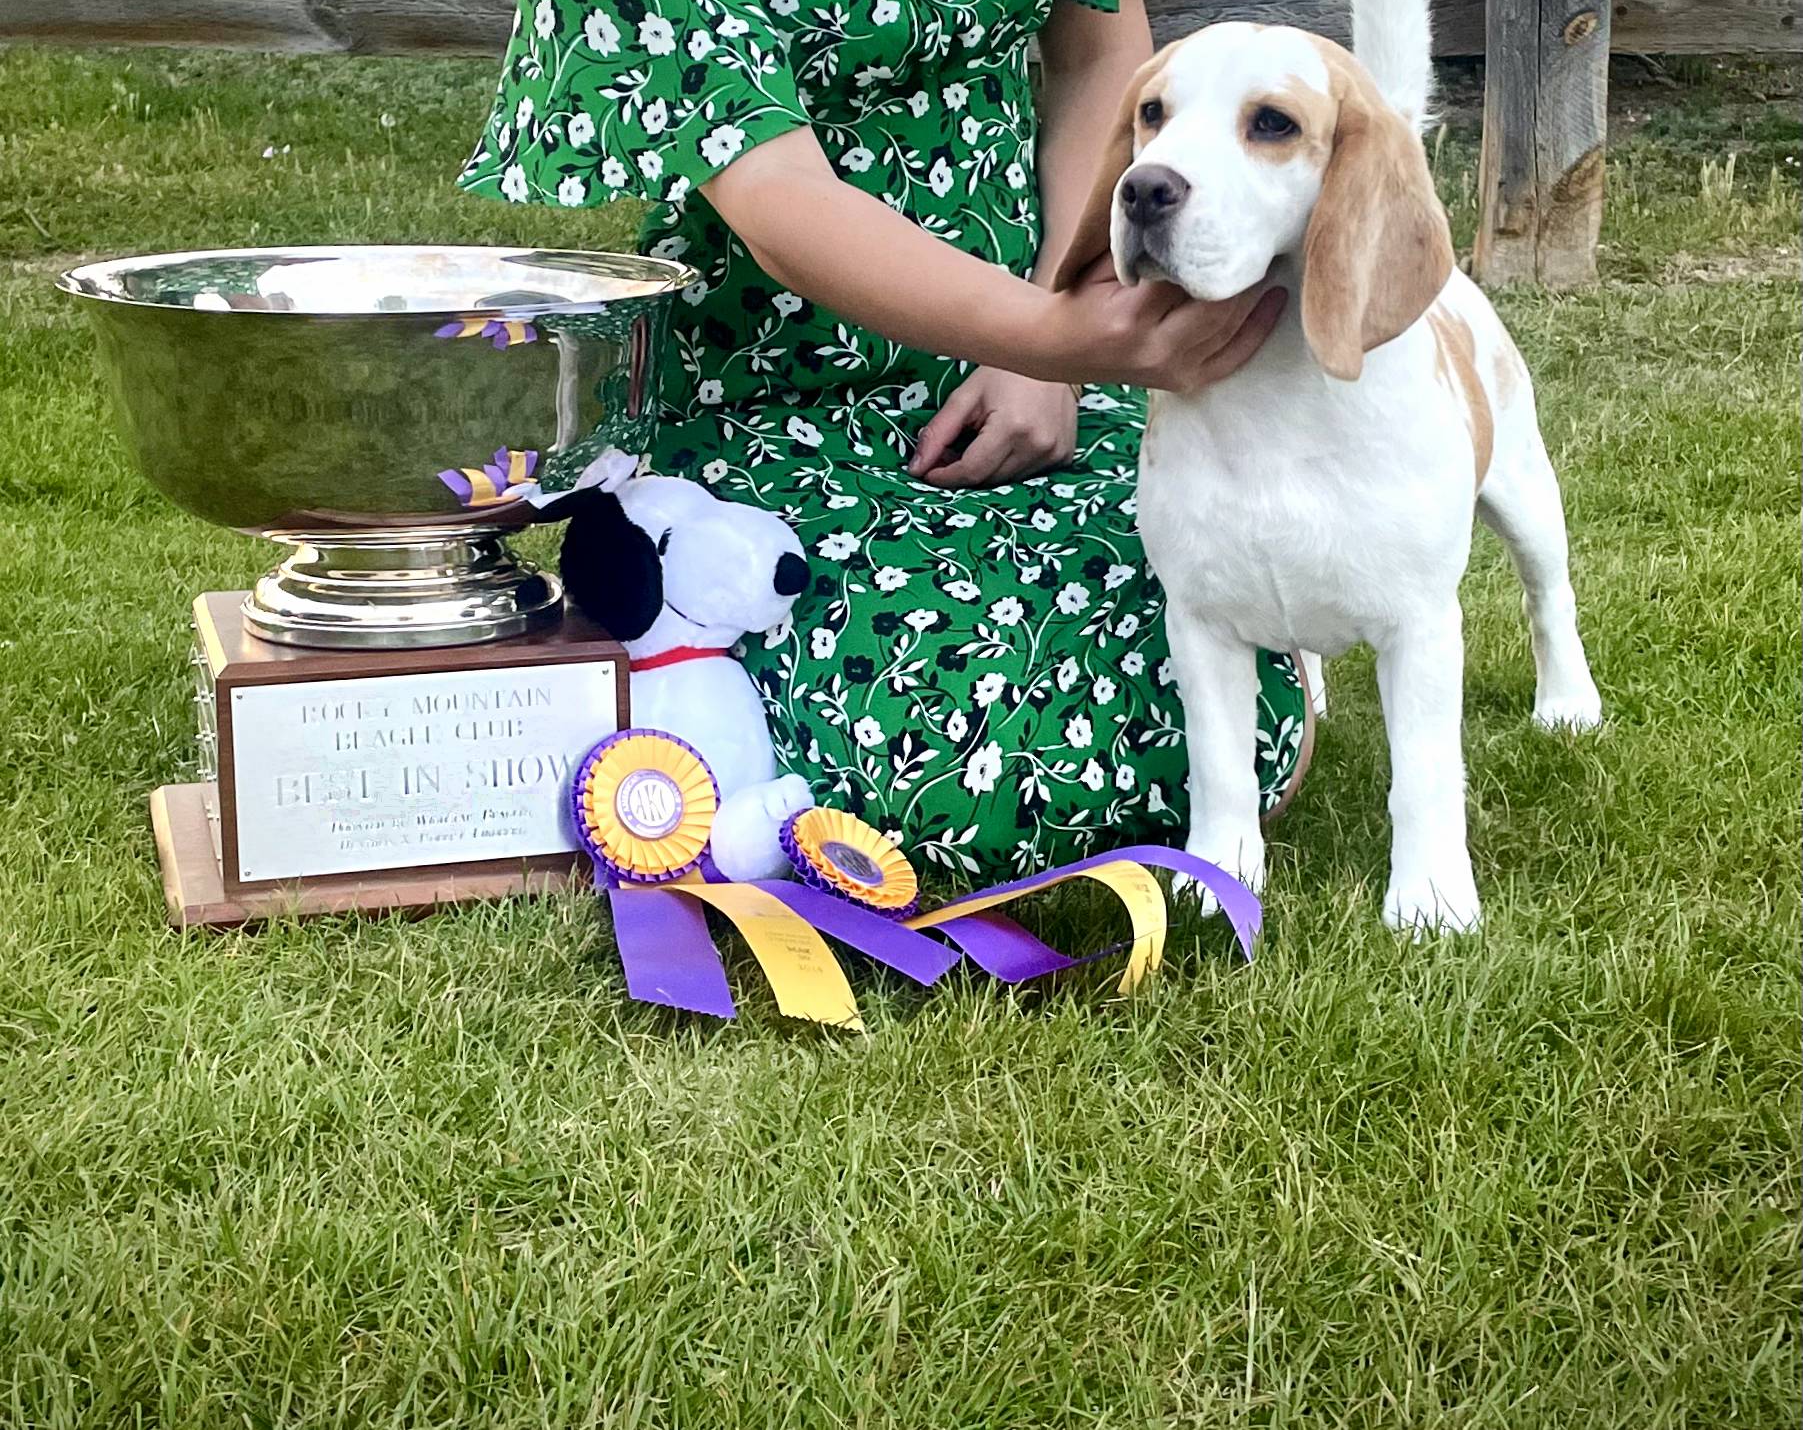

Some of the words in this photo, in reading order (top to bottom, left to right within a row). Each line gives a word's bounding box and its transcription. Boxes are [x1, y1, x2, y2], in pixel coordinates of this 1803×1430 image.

[412, 688, 551, 715] MOUNTAIN
[335, 724, 439, 751] BEAGLE
[456, 719, 524, 742] CLUB
[274, 767, 378, 807] BEST
[402, 764, 441, 795] IN
[465, 753, 576, 789] SHOW
